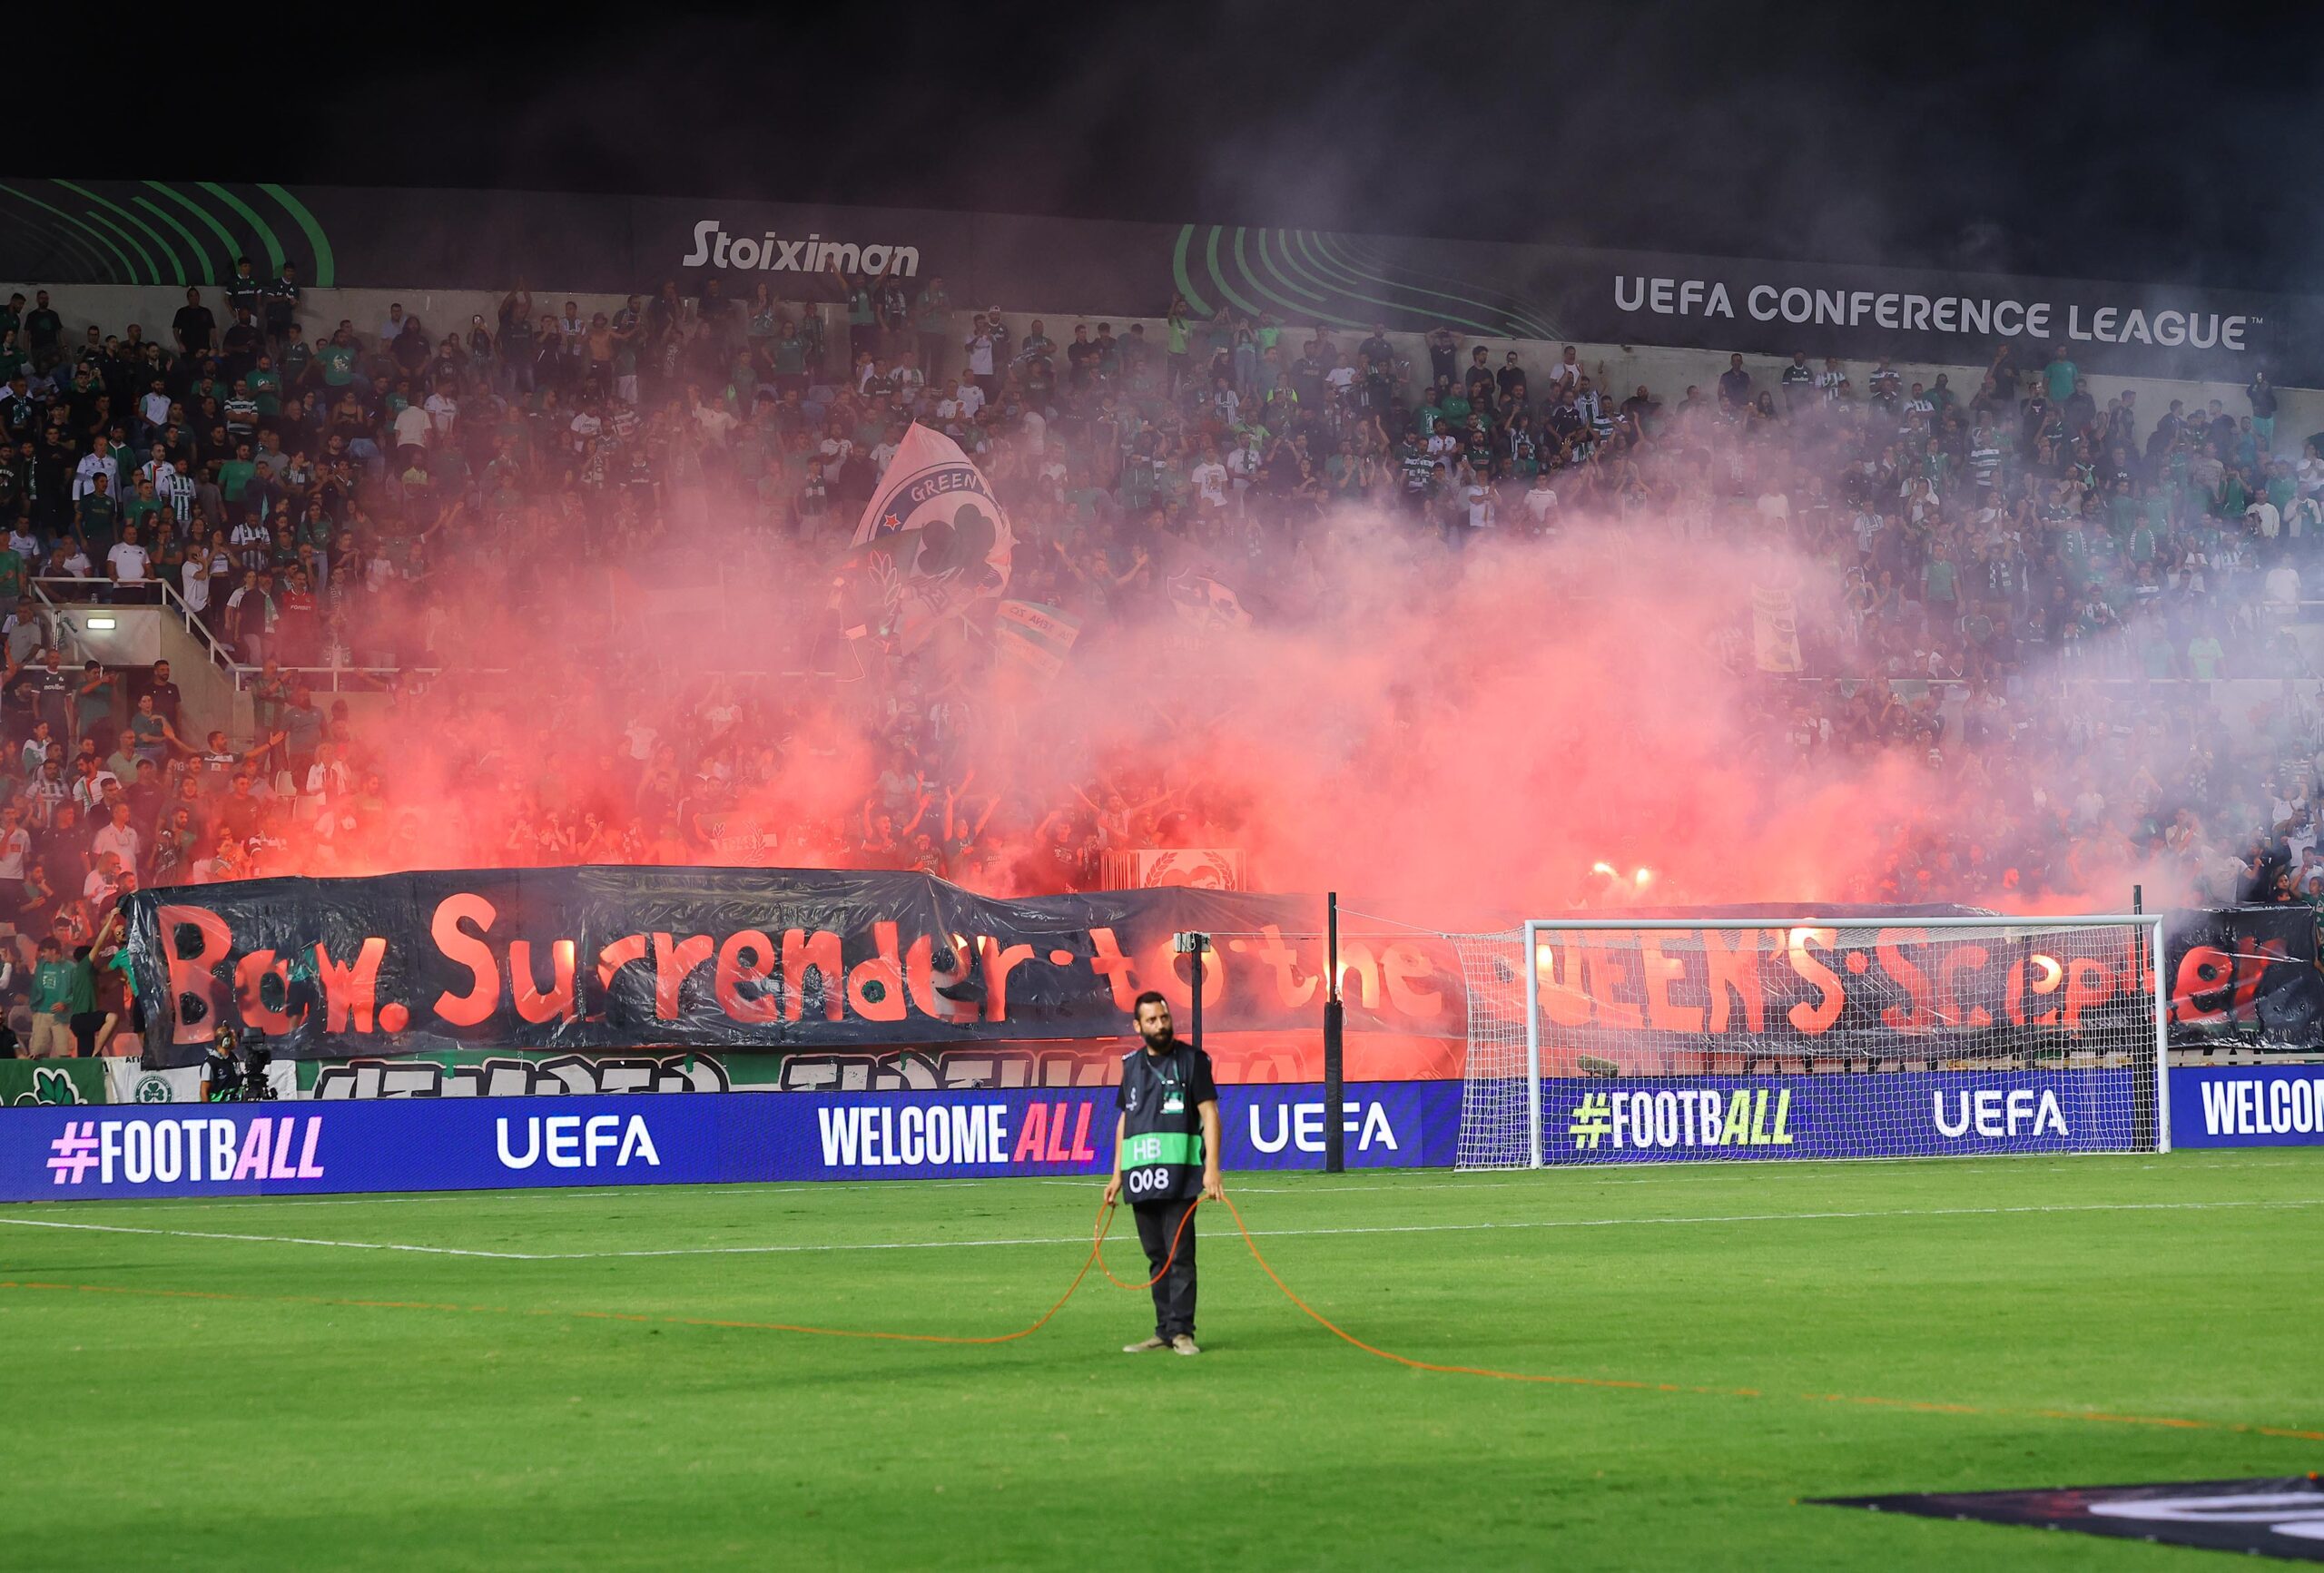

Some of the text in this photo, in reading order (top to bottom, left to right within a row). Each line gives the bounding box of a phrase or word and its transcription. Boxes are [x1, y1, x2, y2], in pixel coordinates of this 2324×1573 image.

[683, 221, 920, 276] Stoiximan
[1614, 275, 1735, 319] UEFA
[1748, 285, 2051, 339] CONFERENCE
[911, 473, 977, 502] GREEN
[431, 893, 1034, 1027] Surrender
[1090, 928, 1225, 1013] to
[1258, 924, 1443, 1018] the
[818, 1102, 1095, 1166] WELCOME ALL
[1248, 1100, 1399, 1154] UEFA
[1569, 1088, 1794, 1150] #FOOTBALL
[1934, 1088, 2069, 1137] UEFA
[46, 1116, 325, 1185] #FOOTBALL
[497, 1114, 660, 1169] UEFA
[1133, 1138, 1161, 1162] HB
[1129, 1167, 1169, 1194] 008
